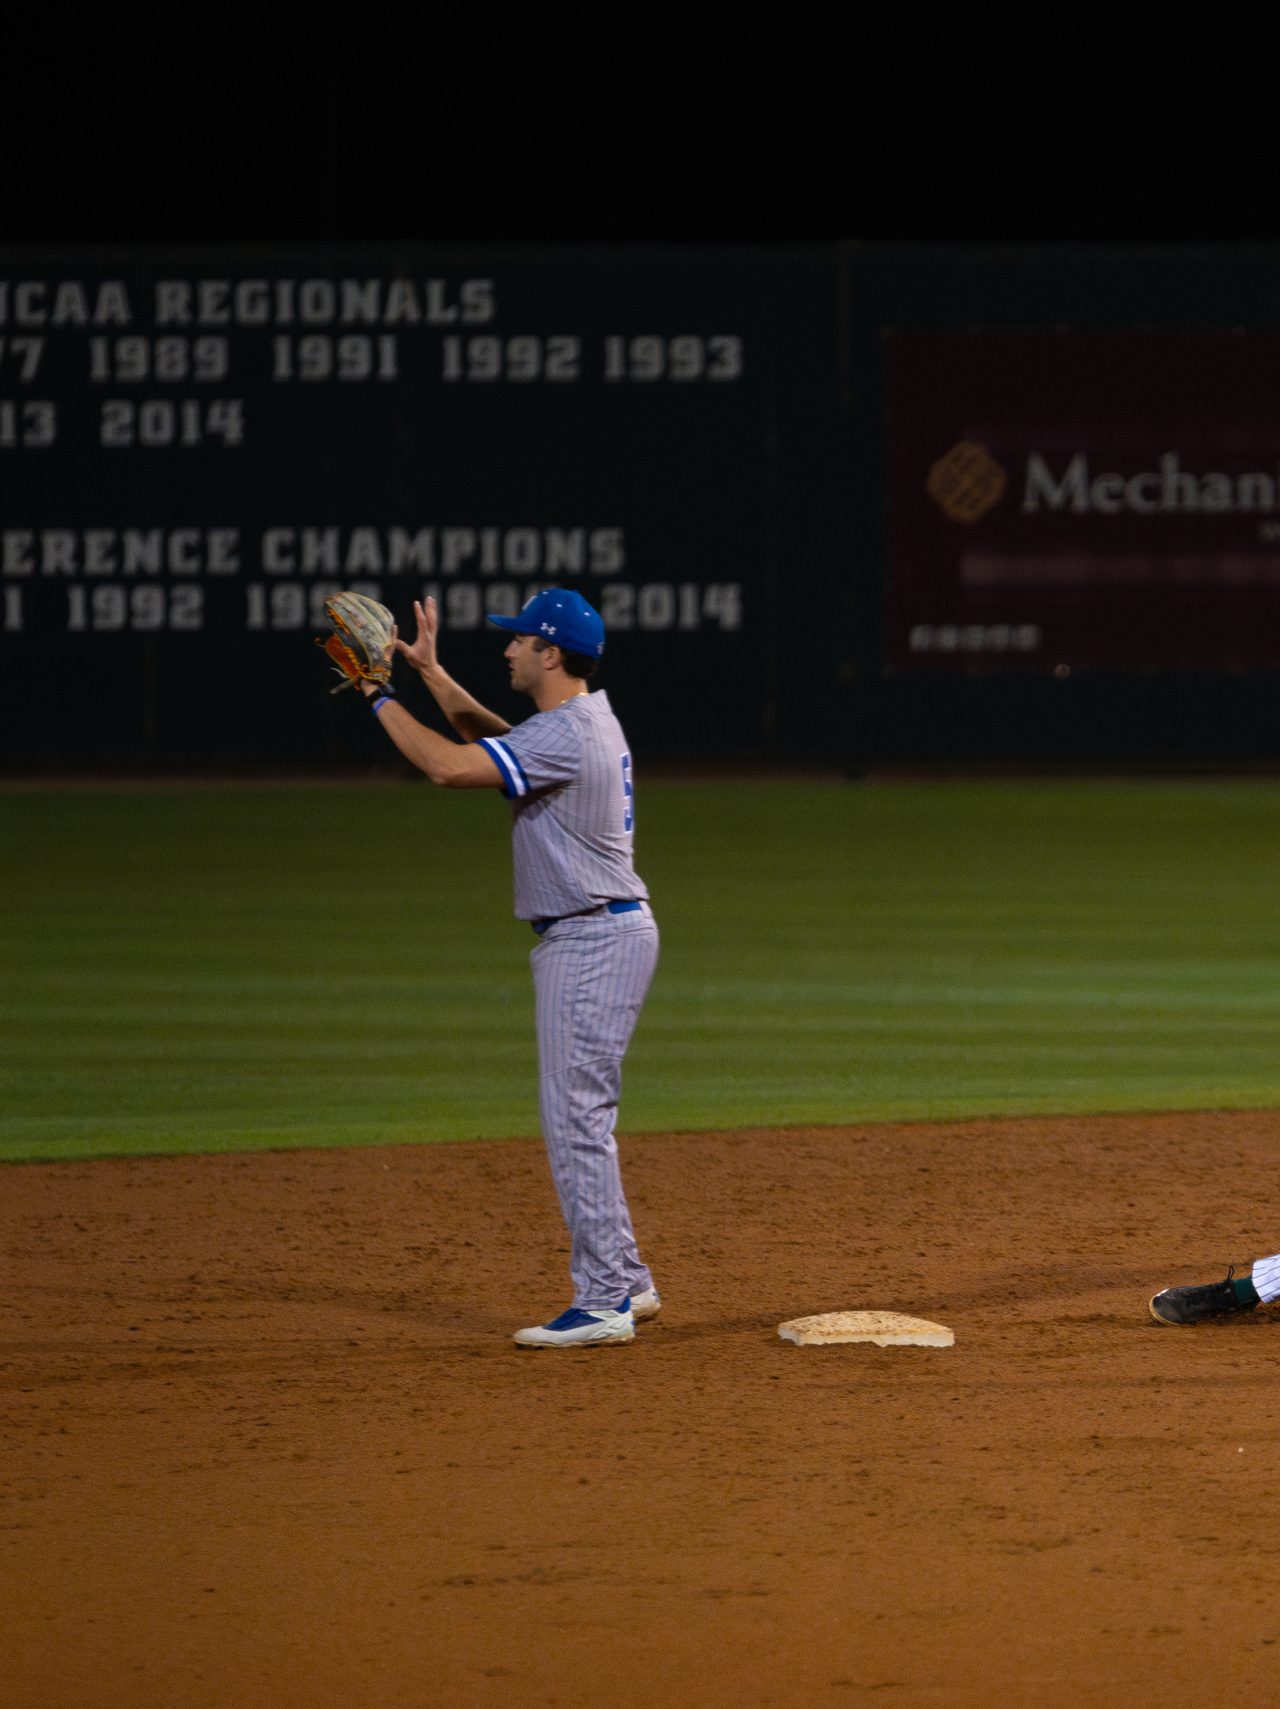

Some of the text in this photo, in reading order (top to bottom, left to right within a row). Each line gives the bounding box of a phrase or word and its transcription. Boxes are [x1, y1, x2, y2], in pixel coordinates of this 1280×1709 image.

[0, 278, 496, 329] CAA REGIONALS
[0, 334, 744, 384] 7 1989 1991 1992 1993
[100, 400, 244, 447] 2014
[1, 526, 626, 577] ERENCE CHAMPIONS
[67, 583, 204, 632] 1992
[601, 583, 743, 631] 2014
